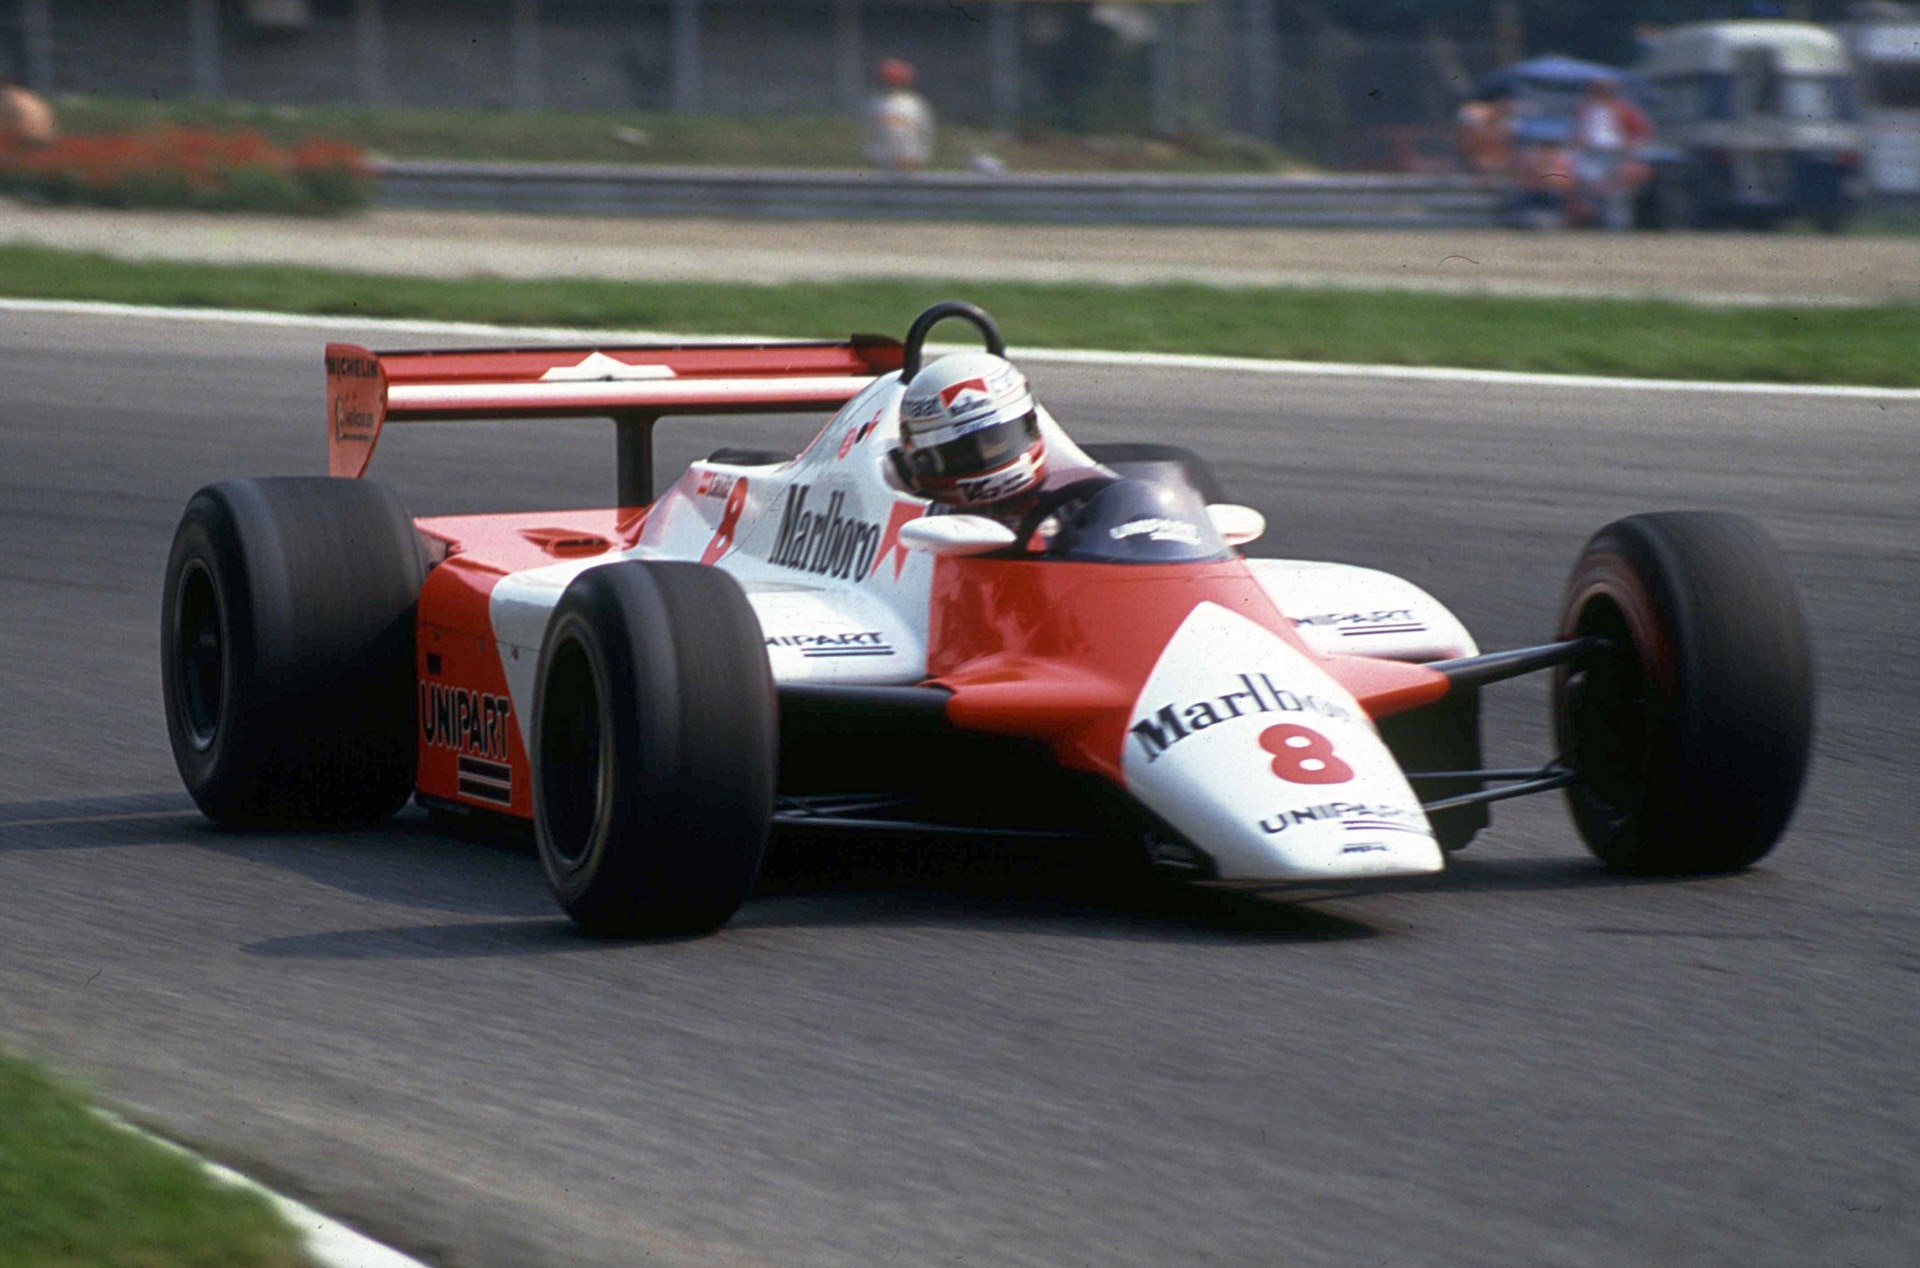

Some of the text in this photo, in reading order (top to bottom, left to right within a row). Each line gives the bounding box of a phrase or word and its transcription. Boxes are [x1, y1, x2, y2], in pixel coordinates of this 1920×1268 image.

[326, 357, 378, 379] MICHELIN
[700, 475, 749, 566] 8
[767, 483, 882, 583] Marlboro
[765, 631, 883, 647] NIPART
[420, 679, 510, 762] UNIPART
[1129, 672, 1348, 764] Marlb
[1258, 723, 1354, 785] 8
[1259, 802, 1413, 834] UNIPAR
